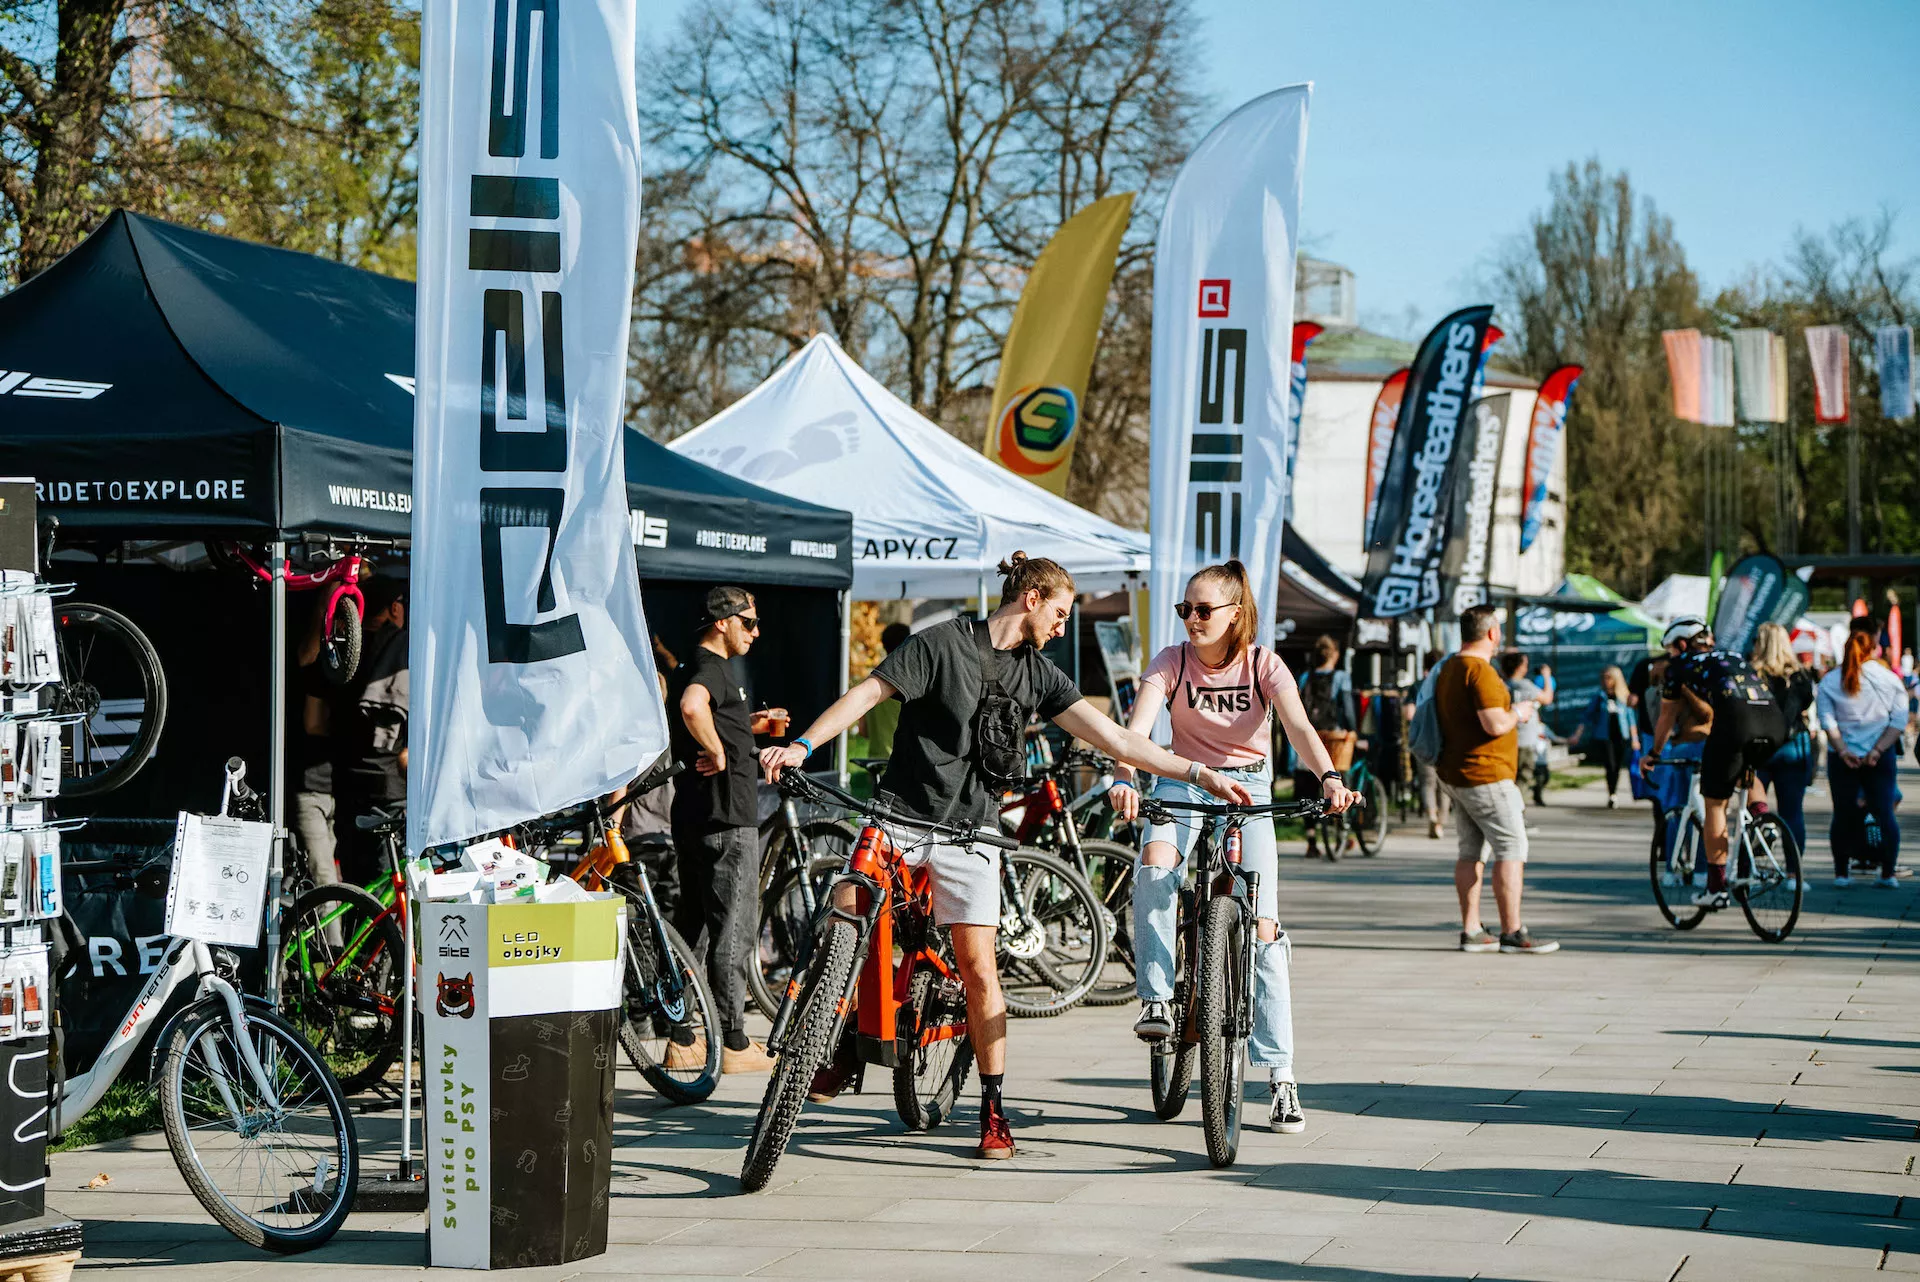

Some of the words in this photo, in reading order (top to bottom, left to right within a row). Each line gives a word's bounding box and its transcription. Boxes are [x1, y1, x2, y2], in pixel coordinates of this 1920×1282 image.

[1390, 322, 1476, 576] Horsefeathers
[328, 484, 412, 514] WWW.PELLS.EU
[852, 537, 959, 560] APY.CZ
[1185, 680, 1251, 713] VANS
[503, 944, 563, 960] obojky
[440, 1044, 458, 1124] prvky
[461, 1082, 475, 1132] PSY
[441, 1137, 457, 1229] Svítící
[465, 1147, 480, 1192] pro
